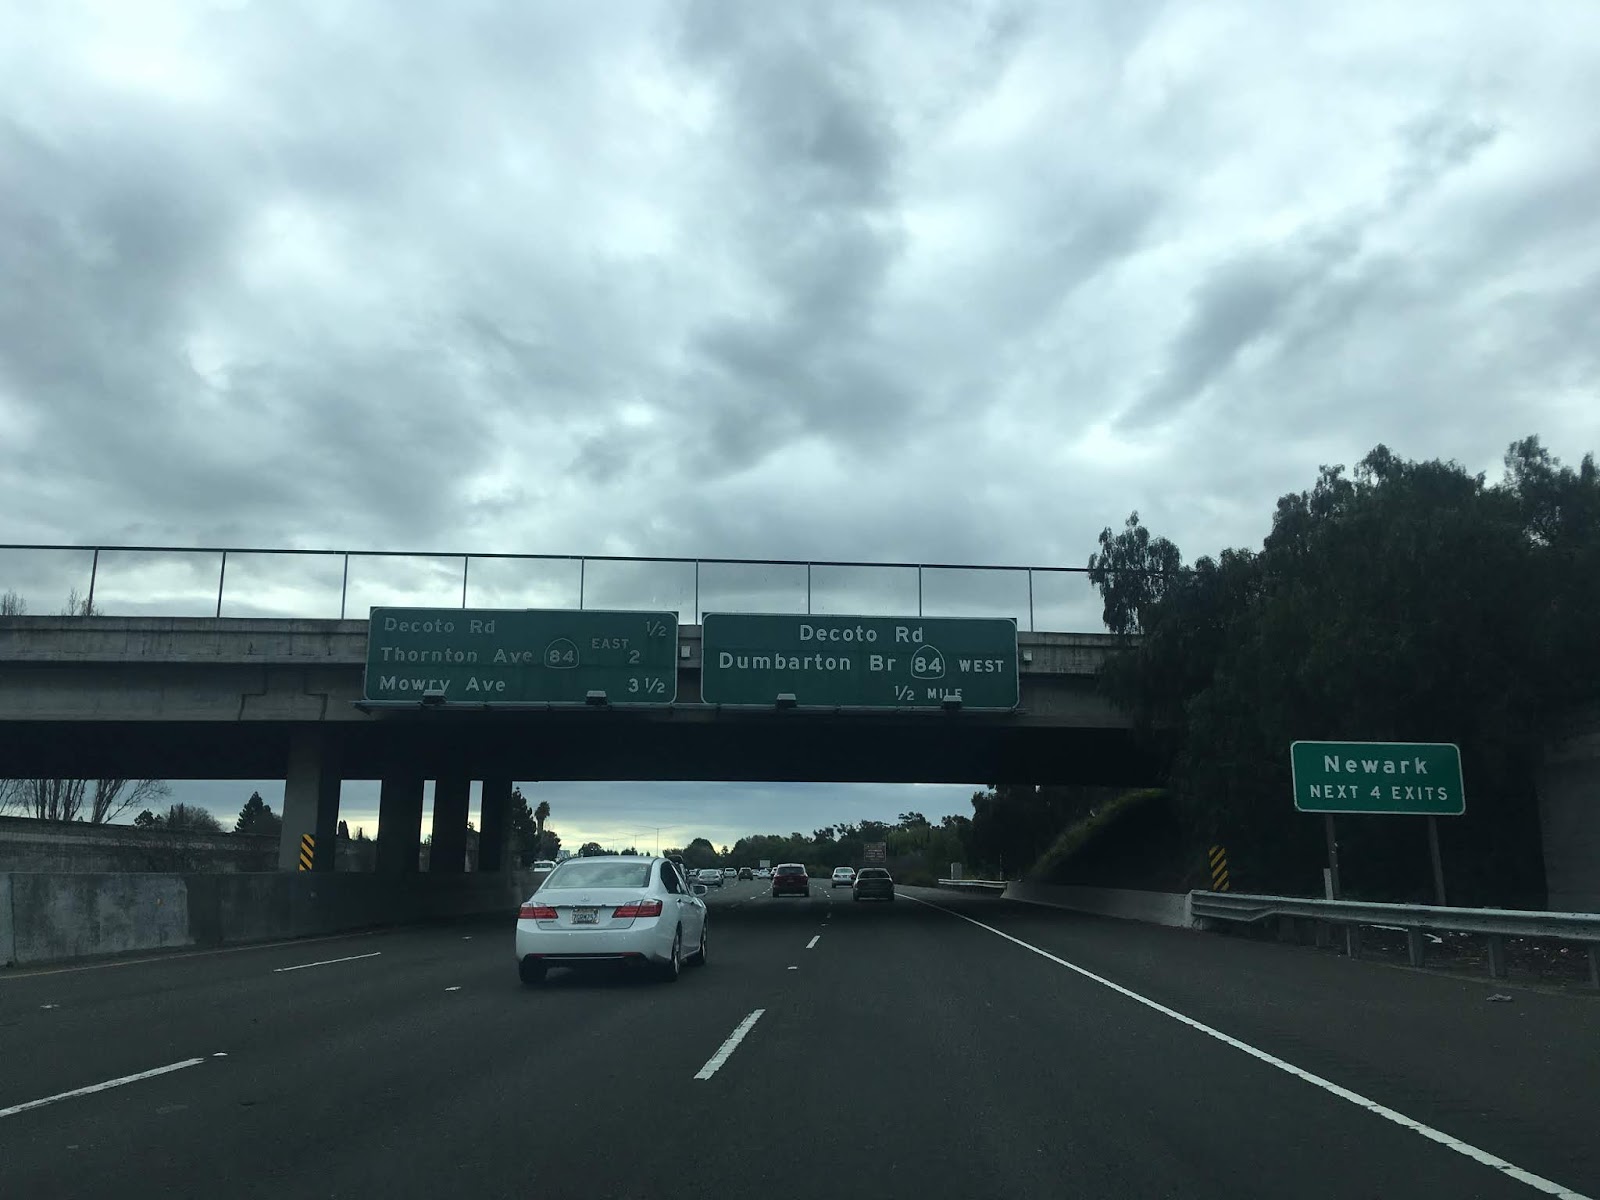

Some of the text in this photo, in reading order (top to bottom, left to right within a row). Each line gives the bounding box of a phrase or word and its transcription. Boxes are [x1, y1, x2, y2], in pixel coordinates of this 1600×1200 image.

[384, 617, 455, 634] Decoto
[469, 619, 496, 635] Rd
[799, 624, 924, 643] Decoto Rd
[381, 638, 641, 664] Thornton Ave 84 EAST 2
[718, 652, 1005, 673] Dumbarton Br 84 WEST
[379, 675, 451, 693] Mowry
[465, 676, 506, 692] Ave
[927, 688, 963, 700] MILE
[1324, 755, 1428, 775] Newark
[1309, 784, 1449, 801] NEXT 4 EXITS
